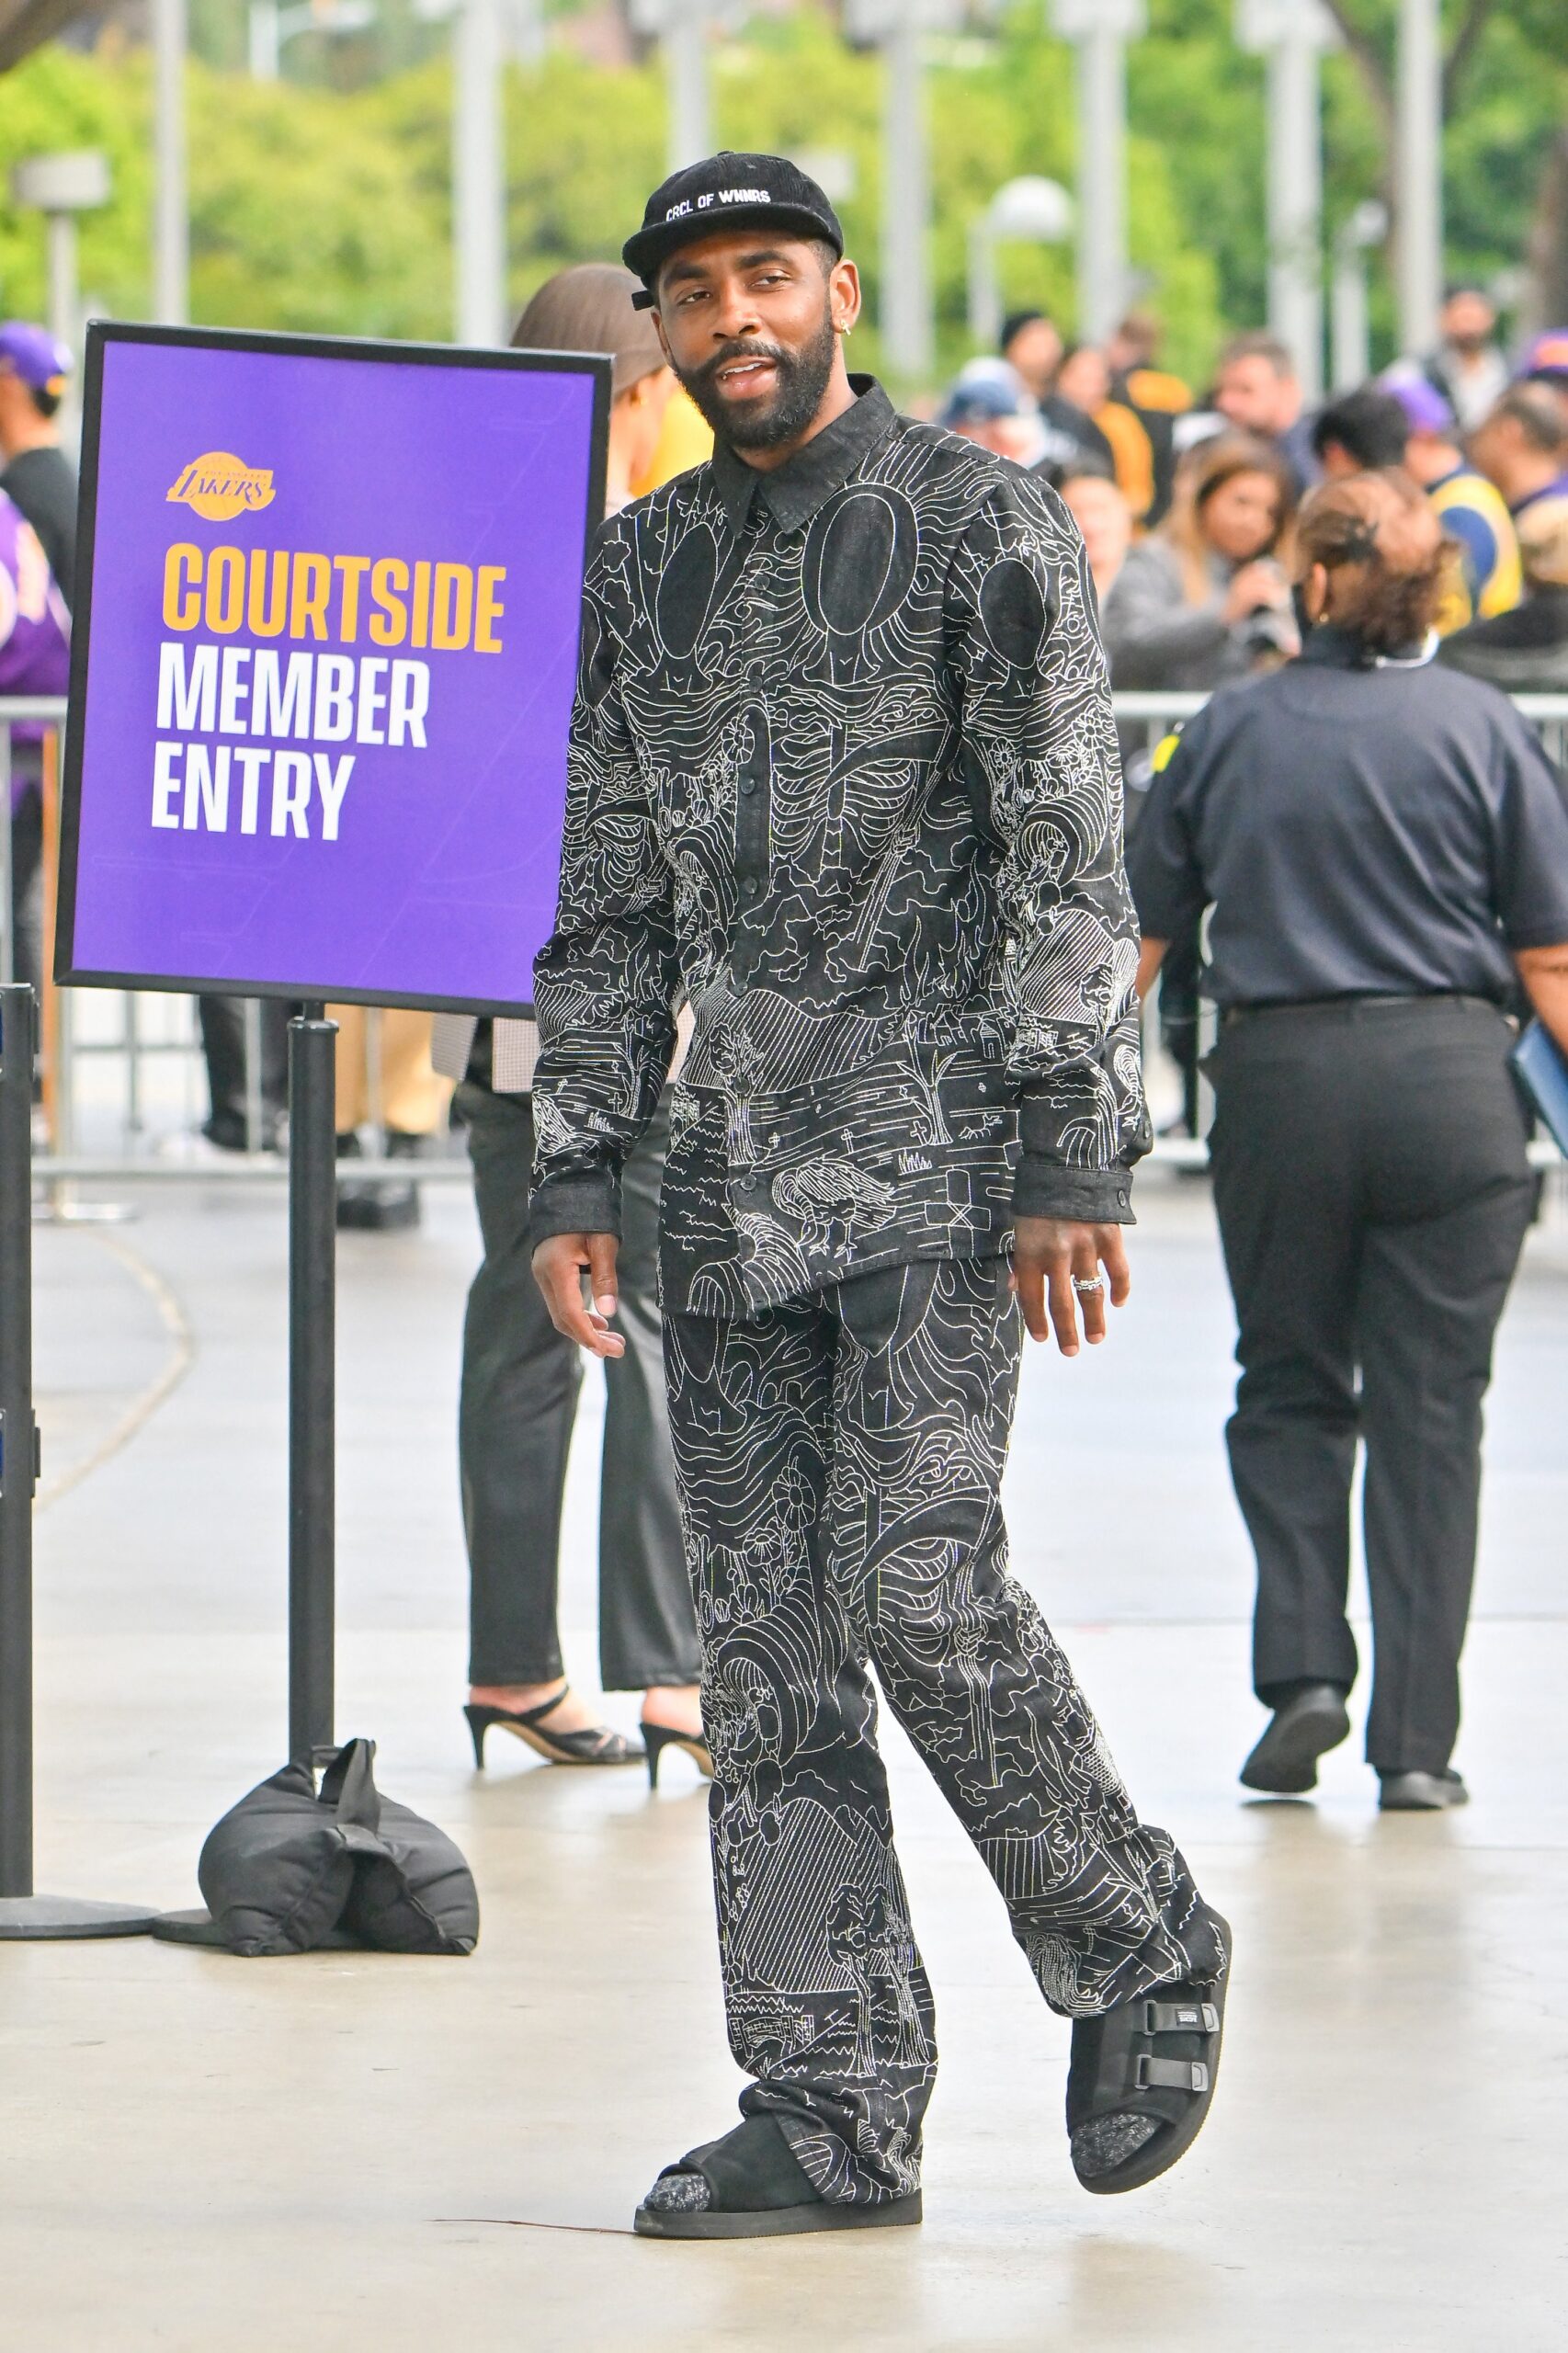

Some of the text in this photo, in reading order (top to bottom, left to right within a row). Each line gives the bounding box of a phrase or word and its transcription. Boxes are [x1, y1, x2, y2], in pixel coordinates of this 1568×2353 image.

[665, 189, 771, 222] CRCL OF WNNRS
[176, 468, 269, 506] LAKERS
[163, 542, 507, 654] COURTSIDE
[157, 642, 430, 748] MEMBER
[152, 741, 356, 840] ENTRY
